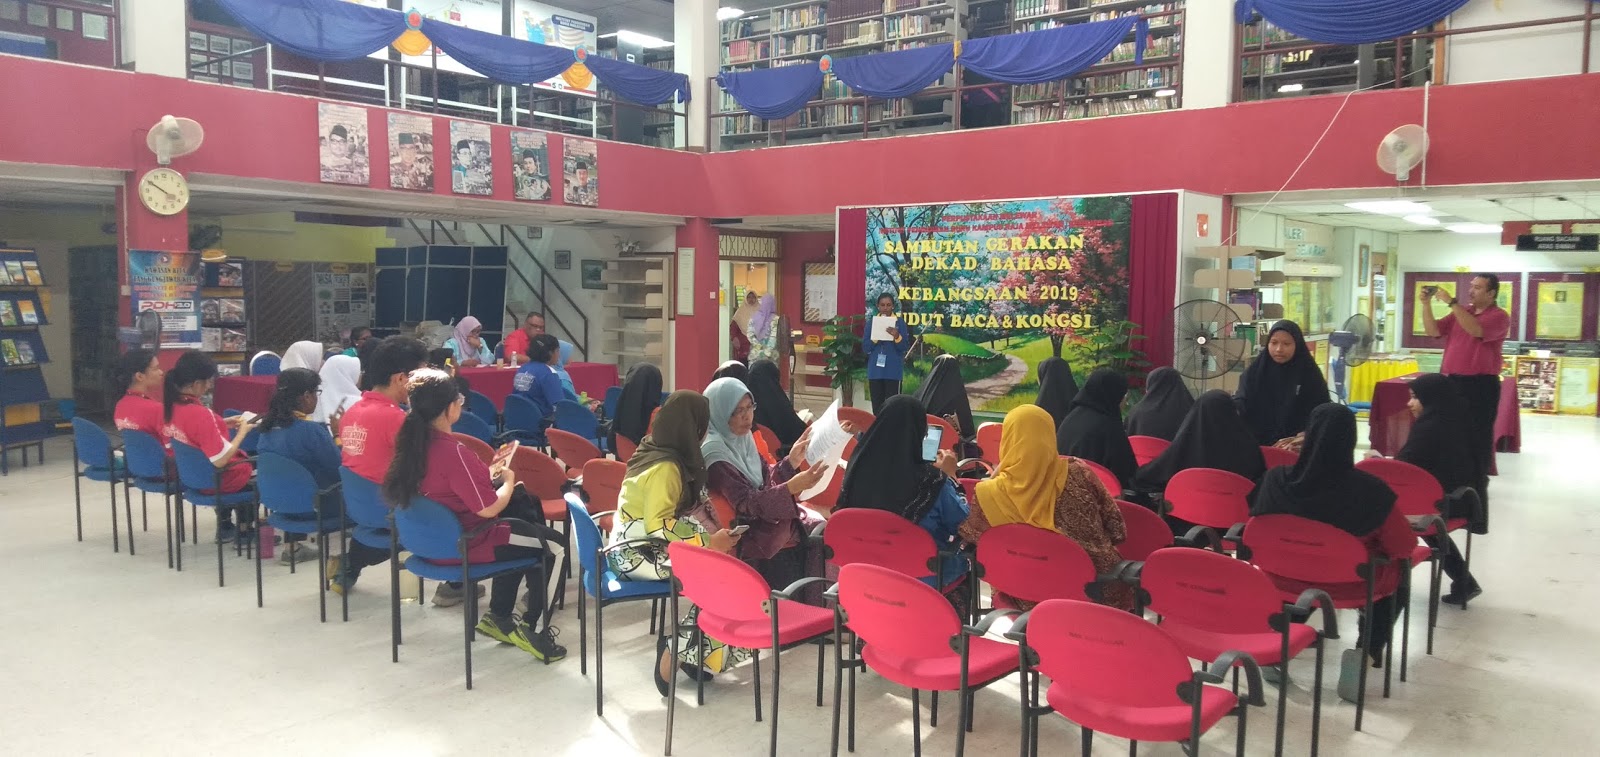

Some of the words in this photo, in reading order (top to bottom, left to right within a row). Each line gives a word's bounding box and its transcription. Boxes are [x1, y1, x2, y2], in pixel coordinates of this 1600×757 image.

[884, 239, 978, 254] SAMBUTAN
[985, 233, 1084, 251] GERAKAN
[912, 256, 977, 271] DEKAD
[990, 255, 1072, 271] BAHASA
[898, 286, 1027, 301] KEBANGSAAN
[1040, 285, 1078, 300] 2019
[896, 312, 945, 327] UDUT
[950, 313, 998, 328] BACA
[1015, 314, 1093, 329] KONGSI
